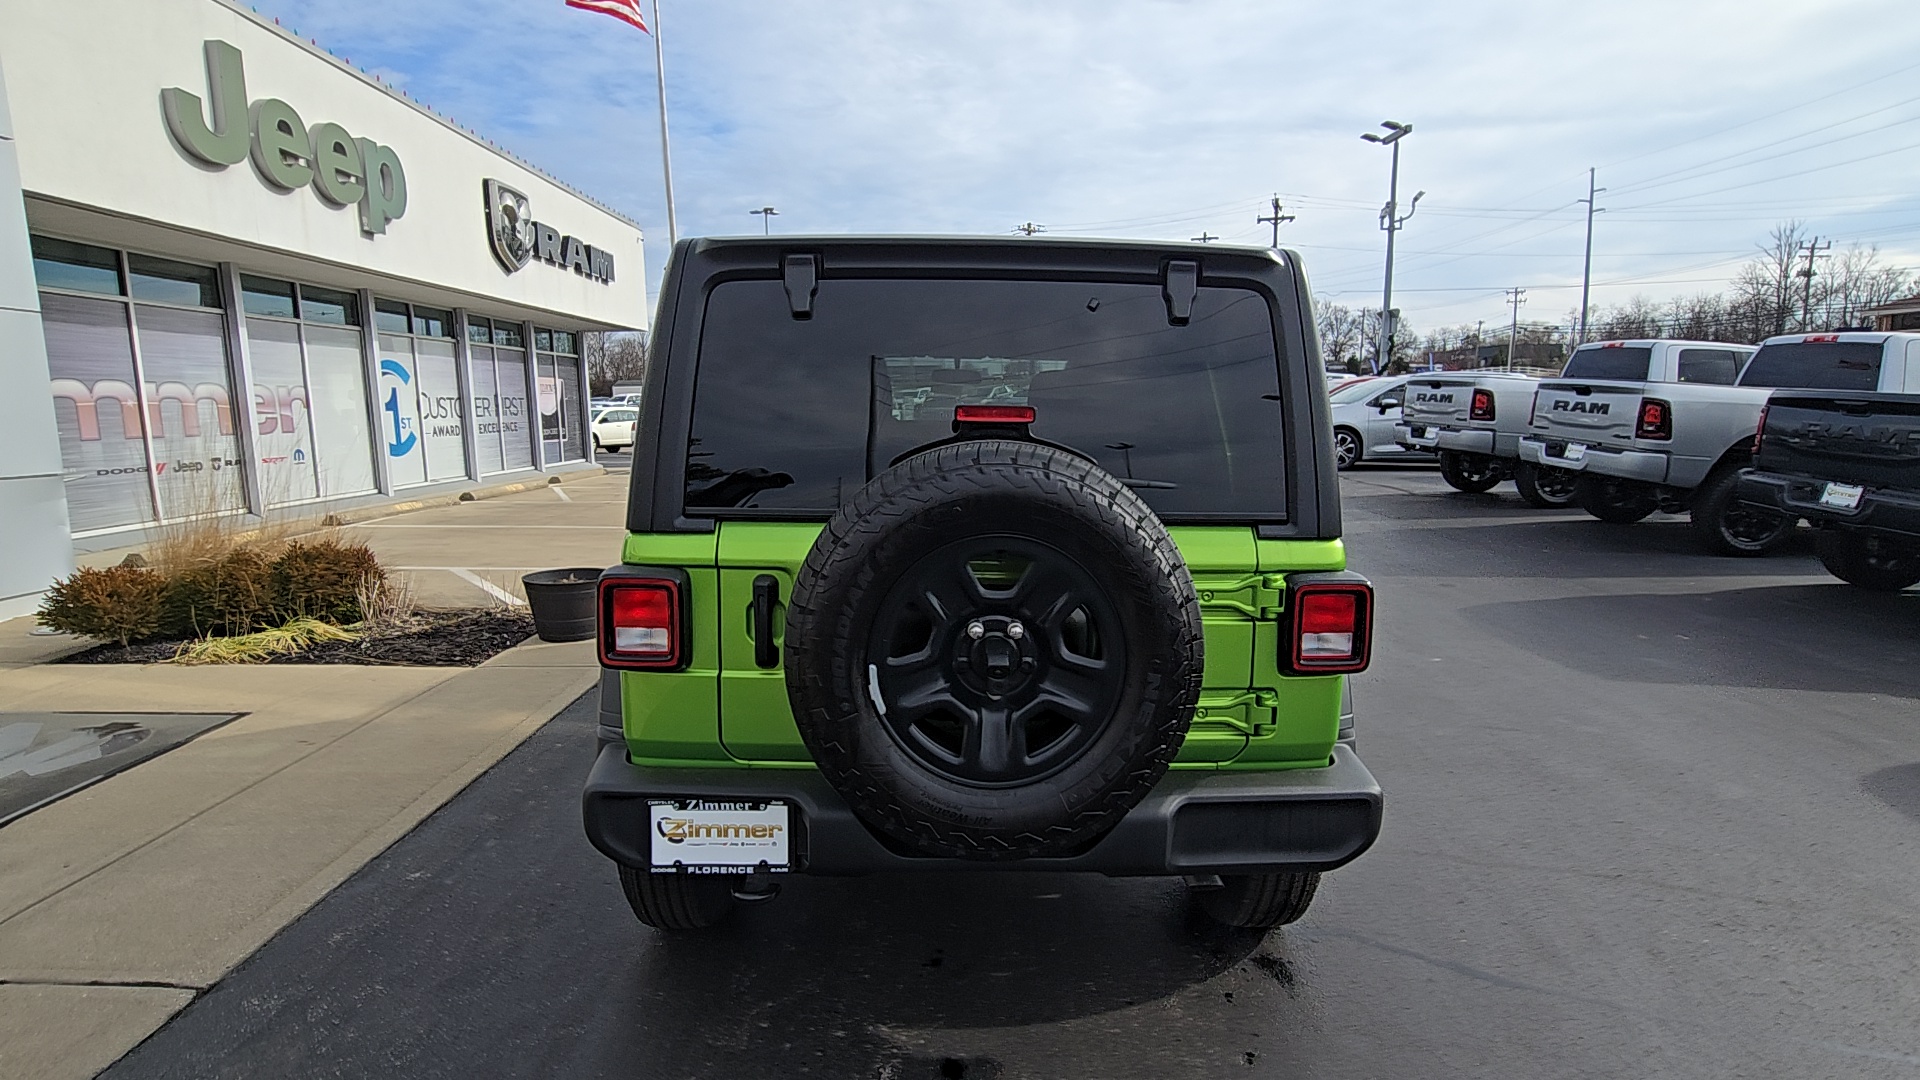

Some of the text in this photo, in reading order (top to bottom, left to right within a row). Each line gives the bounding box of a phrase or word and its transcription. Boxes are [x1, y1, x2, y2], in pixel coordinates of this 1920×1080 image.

[159, 39, 407, 236] Jeep
[532, 220, 616, 284] RAM
[417, 391, 492, 420] CUSTOER
[1416, 393, 1454, 404] RAM
[1552, 399, 1611, 415] RAM
[432, 425, 461, 438] AWARD
[478, 421, 519, 434] EXCELENCE
[1799, 420, 1908, 445] RAM
[97, 466, 149, 477] DODG
[173, 459, 204, 474] Jeep
[225, 459, 243, 467] RA
[686, 800, 753, 811] Zimmer
[665, 818, 783, 840] Zimmer
[687, 866, 755, 874] FLORENCE
